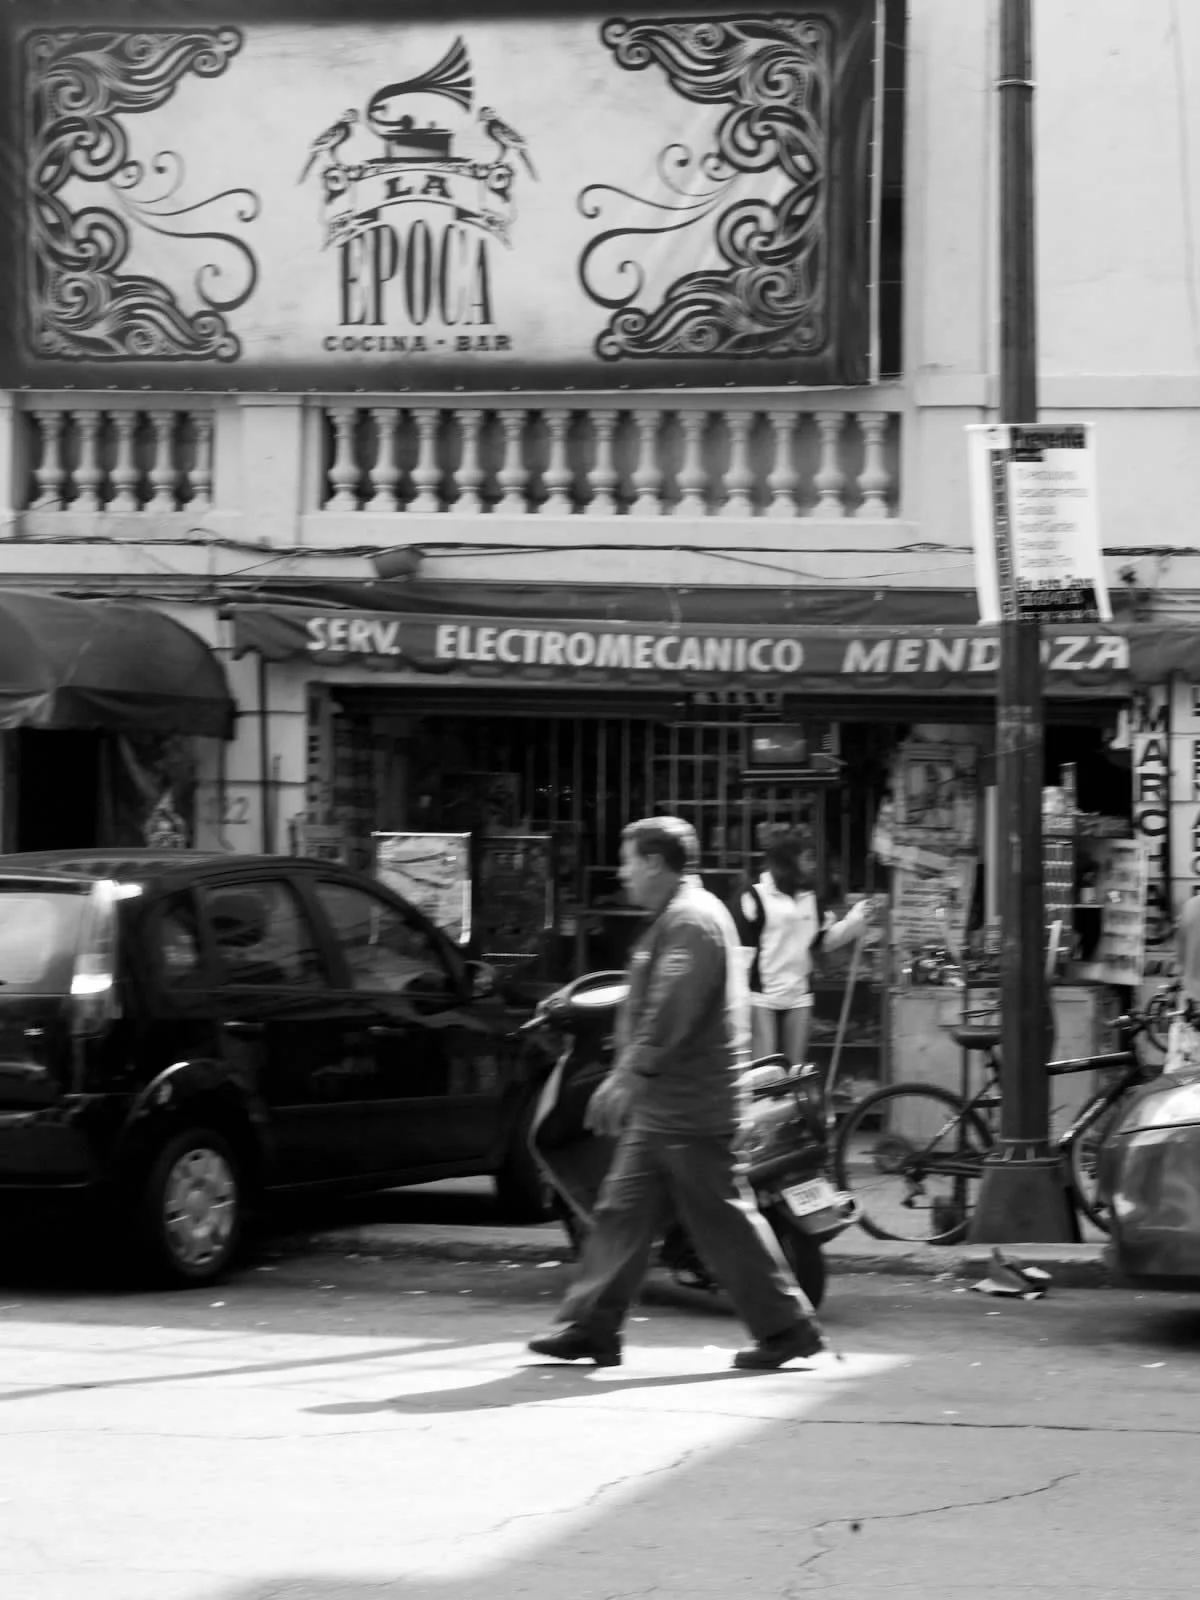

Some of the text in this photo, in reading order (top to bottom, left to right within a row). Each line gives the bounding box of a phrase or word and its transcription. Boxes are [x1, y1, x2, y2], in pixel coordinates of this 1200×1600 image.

[383, 174, 453, 200] LA
[337, 218, 496, 326] EPOCA
[322, 335, 427, 352] COCINA
[455, 335, 513, 352] BAR
[306, 616, 1131, 673] SERV. ELECTROMECANICO MENDZA
